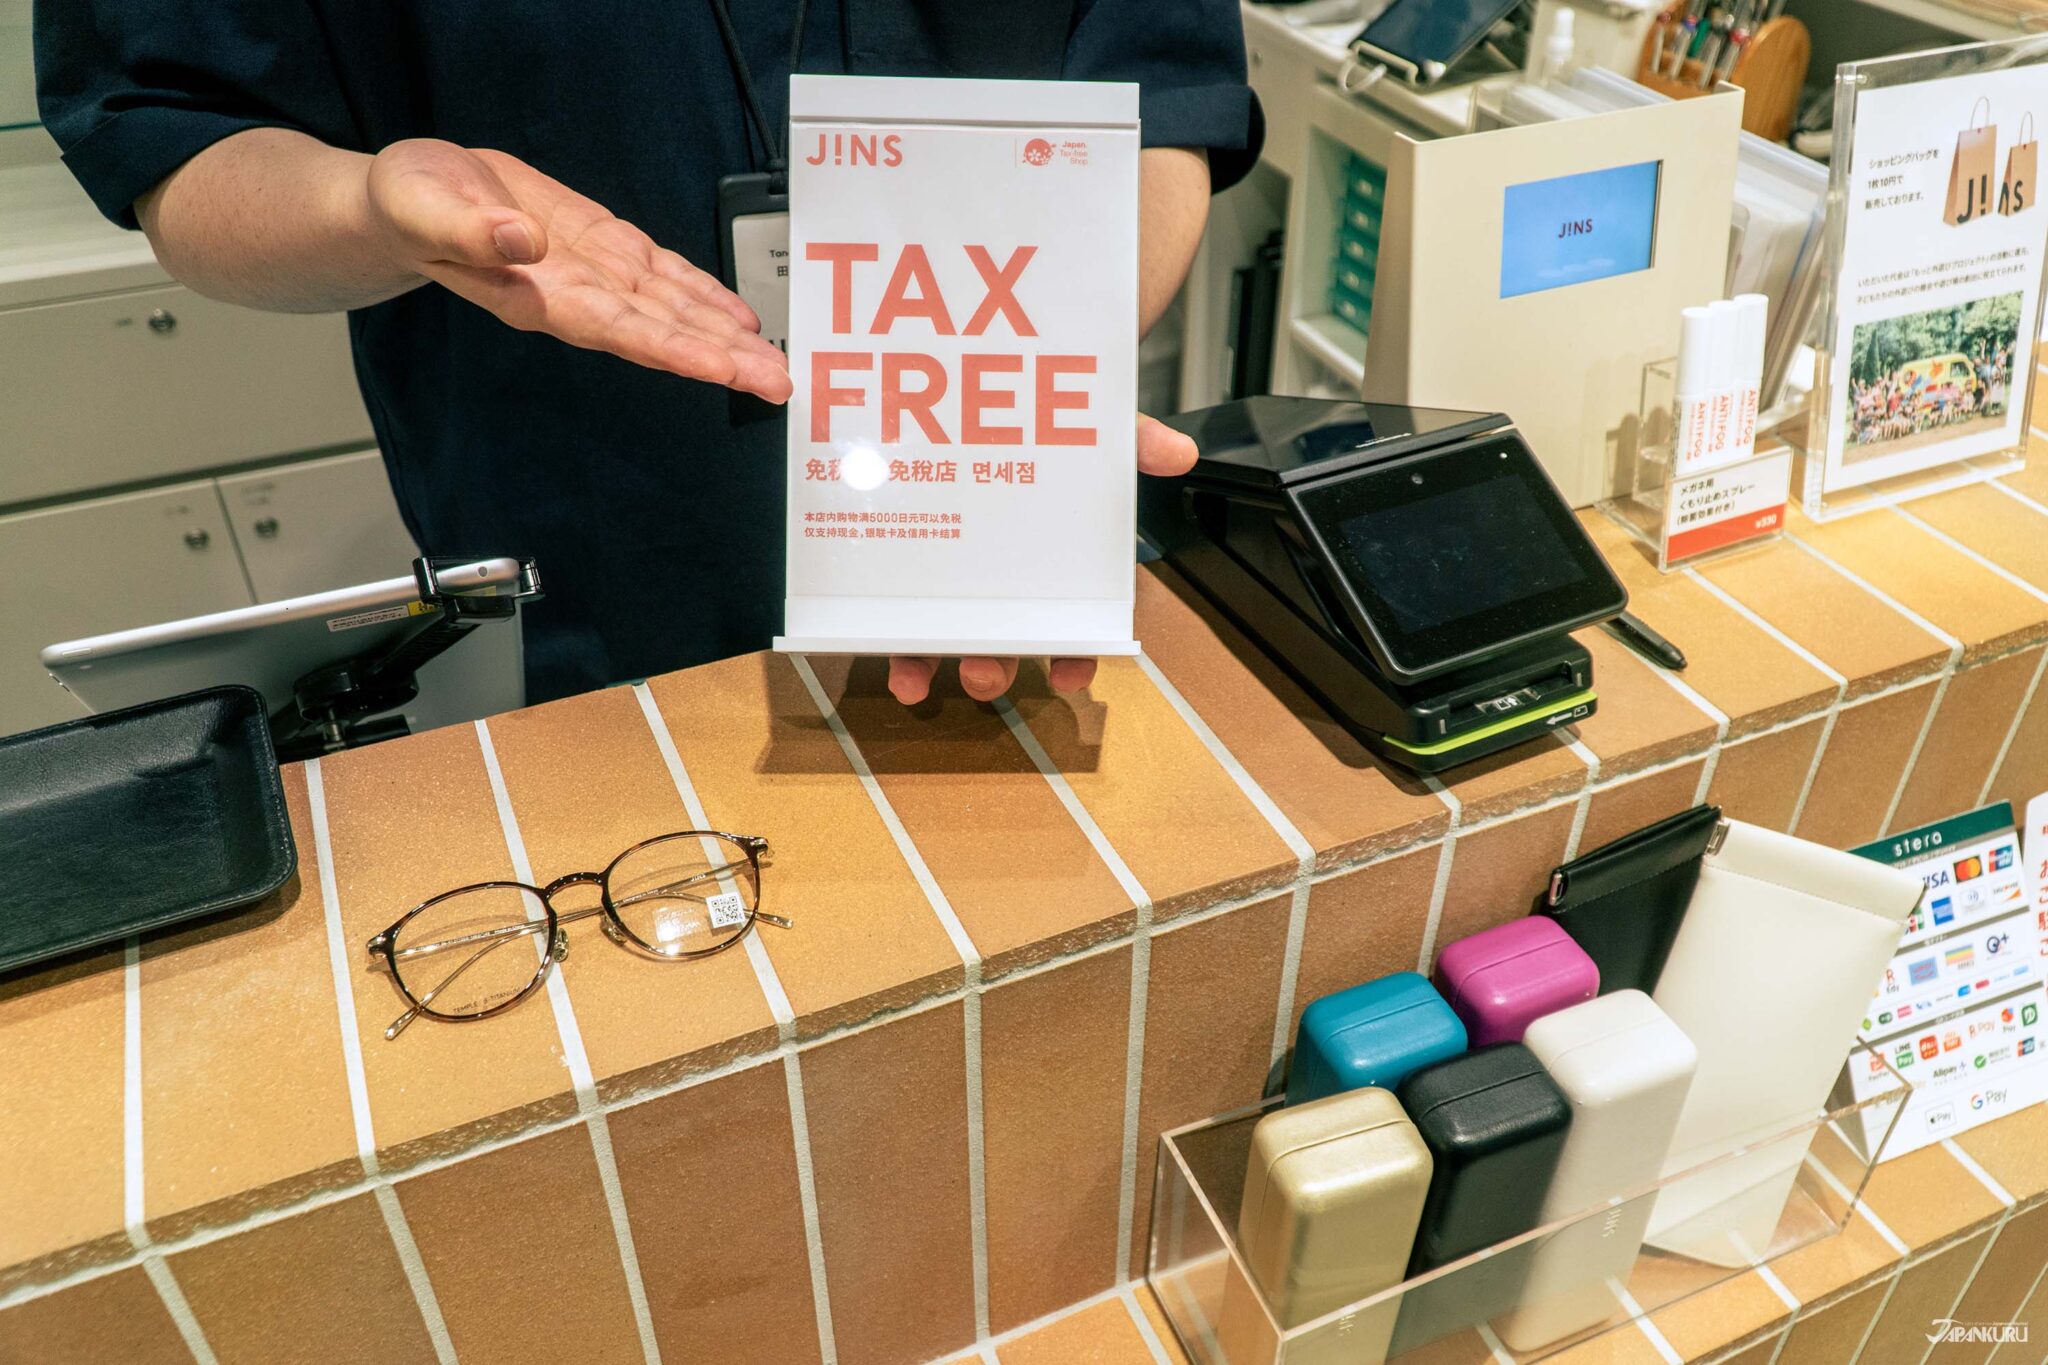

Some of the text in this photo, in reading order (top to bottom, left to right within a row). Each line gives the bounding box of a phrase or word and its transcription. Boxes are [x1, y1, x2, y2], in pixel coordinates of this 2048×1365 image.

[1060, 149, 1088, 158] Tax-free
[1069, 157, 1088, 167] Shop
[805, 242, 1038, 337] TAX
[810, 351, 1098, 447] FREE
[972, 461, 1036, 485] 면세점
[1680, 478, 1714, 495] メガネ用
[1680, 484, 1755, 510] くもり止めスプレー
[804, 511, 961, 524] 本店内购物满5000日元可以免税
[1894, 830, 1942, 857] stera
